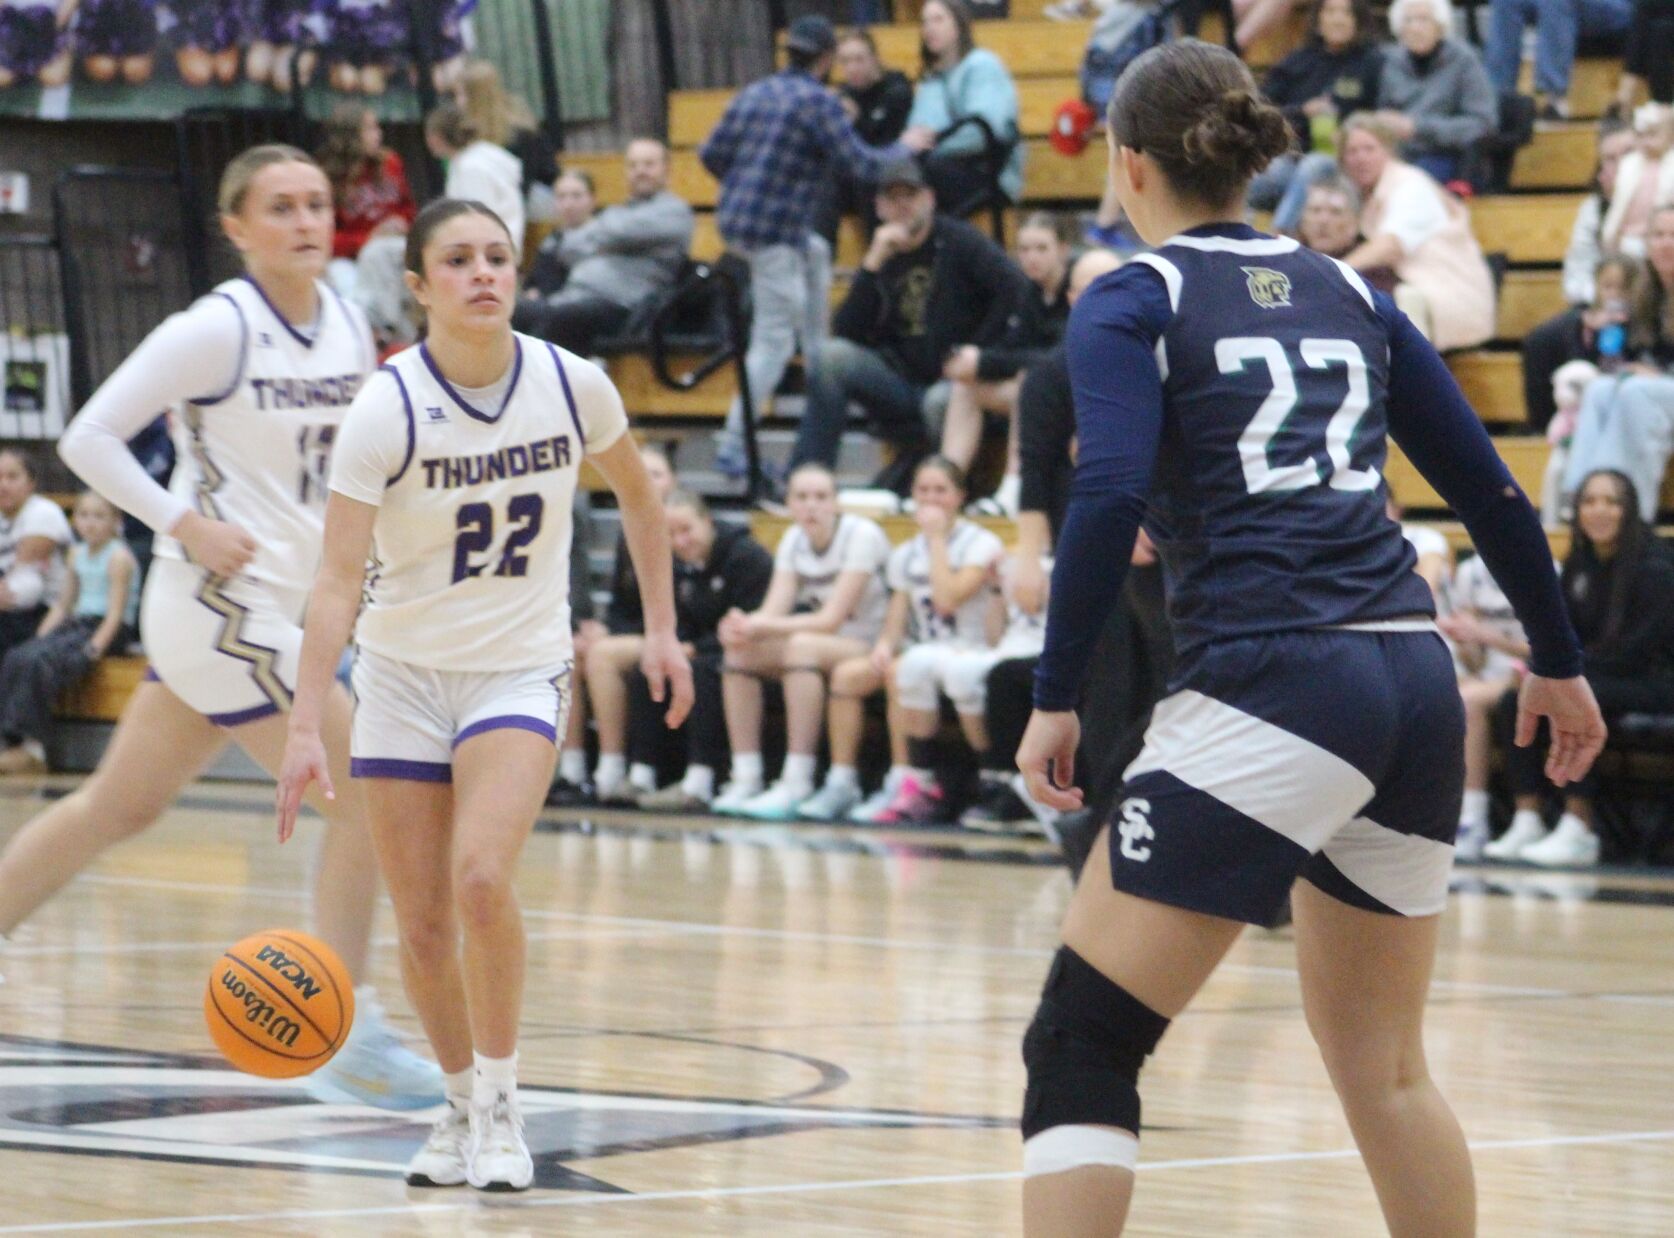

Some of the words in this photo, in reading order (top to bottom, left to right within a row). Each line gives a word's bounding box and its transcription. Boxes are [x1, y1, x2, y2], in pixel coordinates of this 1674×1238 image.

[251, 374, 362, 410] THUNDE
[1214, 336, 1381, 494] 22
[421, 435, 571, 489] THUNDER
[451, 493, 544, 586] 22
[1118, 797, 1155, 863] SC
[256, 945, 321, 1001] NCAA
[221, 970, 301, 1048] Wilson
